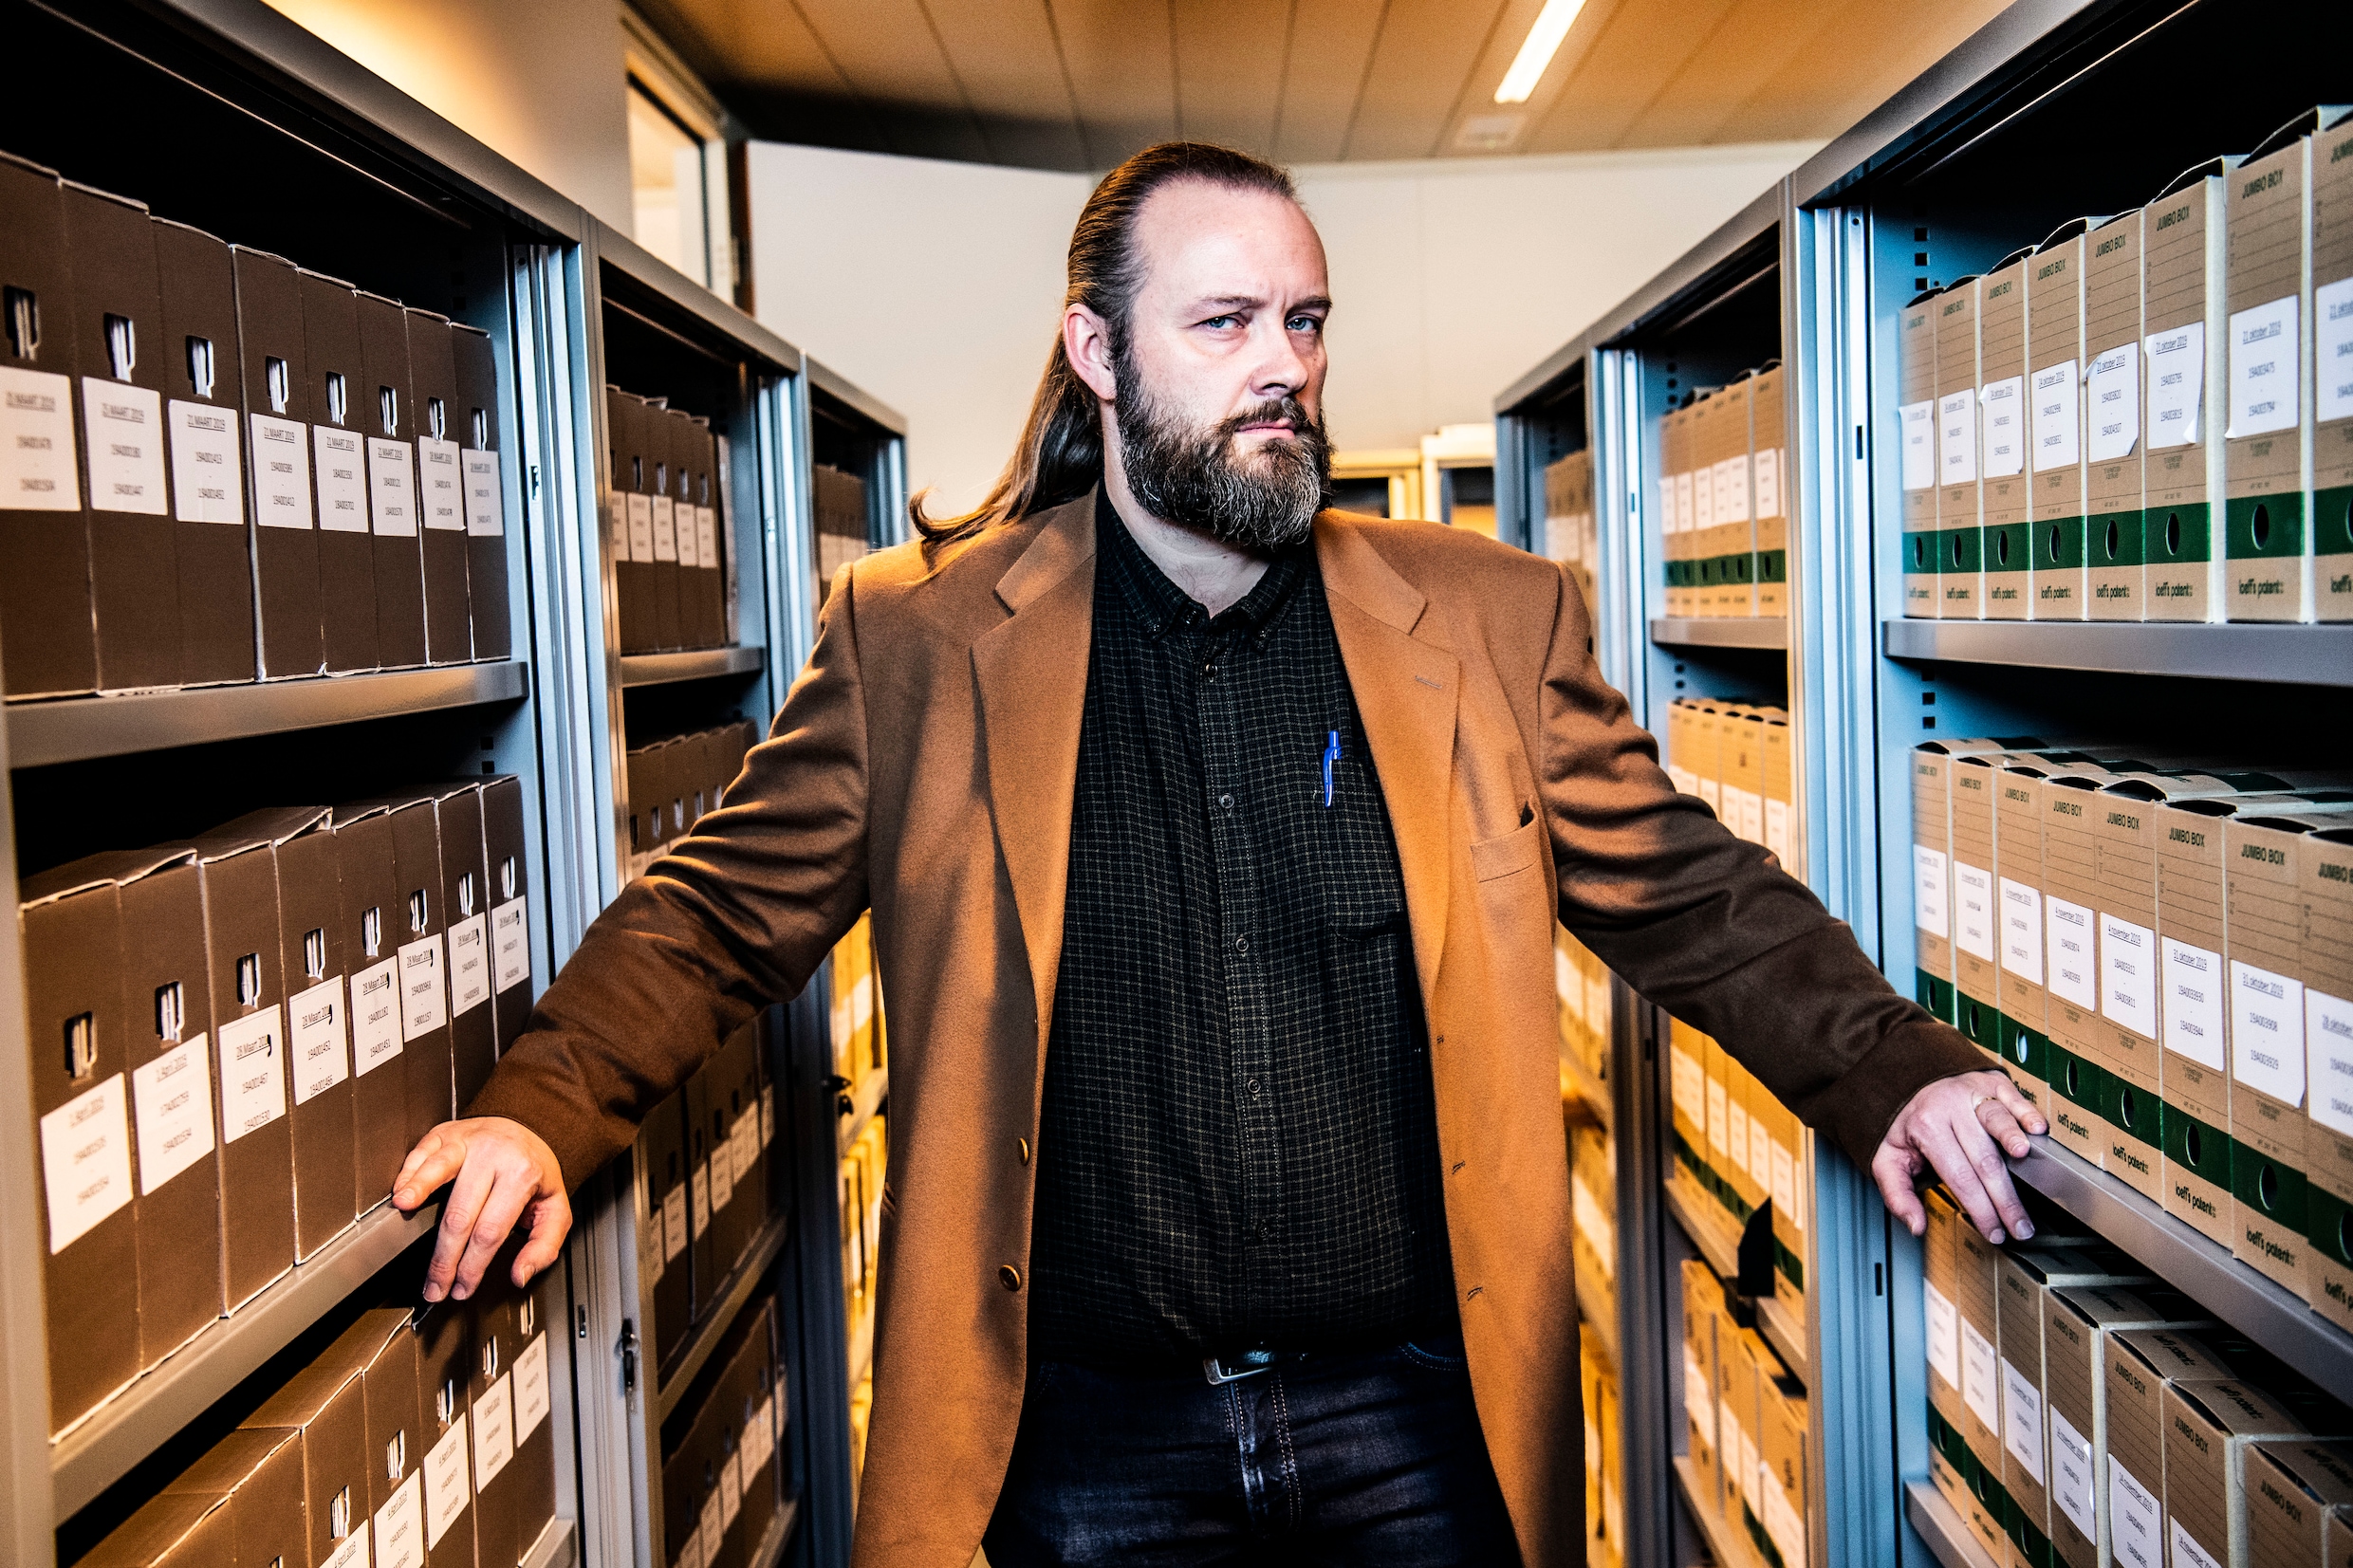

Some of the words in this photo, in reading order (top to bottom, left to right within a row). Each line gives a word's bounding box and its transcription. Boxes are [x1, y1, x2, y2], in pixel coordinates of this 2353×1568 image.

[2242, 175, 2267, 199] JUMBO
[2267, 168, 2284, 191] BOX
[2157, 210, 2177, 231] JUMBO
[2177, 205, 2190, 222] BOX
[2096, 238, 2114, 258] JUMBO
[2115, 233, 2126, 249] BOX
[2038, 262, 2055, 281] JUMBO
[2056, 258, 2066, 273] BOX
[2250, 323, 2269, 341] oktober
[2269, 320, 2282, 336] 2019
[2162, 338, 2177, 352] oktober
[2177, 335, 2188, 348] 2019
[2103, 357, 2116, 371] oktober
[2117, 354, 2125, 367] 2019
[2043, 373, 2055, 386] oktober
[2056, 370, 2065, 382] 2019
[195, 415, 213, 428] MAART
[213, 418, 225, 429] 2019
[264, 427, 269, 437] 21
[269, 428, 285, 440] MAART
[285, 431, 295, 441] 2019
[332, 437, 345, 449] MAART
[345, 440, 355, 450] 2019
[382, 448, 394, 457] MAART
[2041, 585, 2052, 599] loeff's
[2053, 586, 2067, 601] patent
[2096, 584, 2110, 598] loeff's
[2110, 584, 2127, 601] patent
[2156, 581, 2171, 597] loeff's
[2172, 582, 2190, 600] patent
[2239, 579, 2257, 595] loeff's
[2258, 580, 2280, 599] patent
[1960, 777, 1972, 788] JUMBO
[1973, 780, 1981, 791] BOX
[2005, 787, 2018, 801] JUMBO
[2018, 791, 2029, 804] BOX
[2053, 801, 2070, 814] JUMBO
[2070, 804, 2082, 818] BOX
[2107, 812, 2127, 827] JUMBO
[2127, 817, 2140, 831] BOX
[2169, 827, 2189, 844] JUMBO
[2191, 833, 2205, 848] BOX
[2241, 843, 2267, 861] JUMBO
[2268, 849, 2285, 866] BOX
[2319, 862, 2347, 884] JUMBO
[2009, 888, 2023, 902] november
[2058, 907, 2075, 921] november
[2075, 913, 2084, 924] 2019
[2111, 925, 2130, 941] november
[2131, 932, 2140, 945] 2019
[406, 956, 412, 967] 28
[412, 951, 423, 965] Maart
[2179, 950, 2195, 966] oktober
[2196, 955, 2207, 969] 2019
[362, 982, 368, 994] 28
[368, 976, 380, 991] Maart
[2243, 972, 2249, 987] 31
[2250, 975, 2270, 993] oktober
[2270, 982, 2284, 998] 2019
[302, 1014, 307, 1027] 28
[308, 1008, 321, 1024] Maart
[244, 1039, 258, 1055] Maart
[2058, 1110, 2068, 1129] loeff's
[2070, 1119, 2085, 1137] patent
[2113, 1141, 2126, 1162] loeff's
[2128, 1153, 2145, 1172] patent
[2176, 1180, 2191, 1204] loeff's
[2193, 1195, 2213, 1217] patent
[2247, 1225, 2264, 1250] loeff's
[2266, 1241, 2289, 1265] patent
[2115, 1361, 2133, 1386] JUMBO
[2134, 1377, 2146, 1396] BOX
[2175, 1415, 2194, 1444] JUMBO
[2194, 1435, 2209, 1455] BOX
[2260, 1480, 2283, 1510] JUMBO
[2282, 1497, 2302, 1523] BOX
